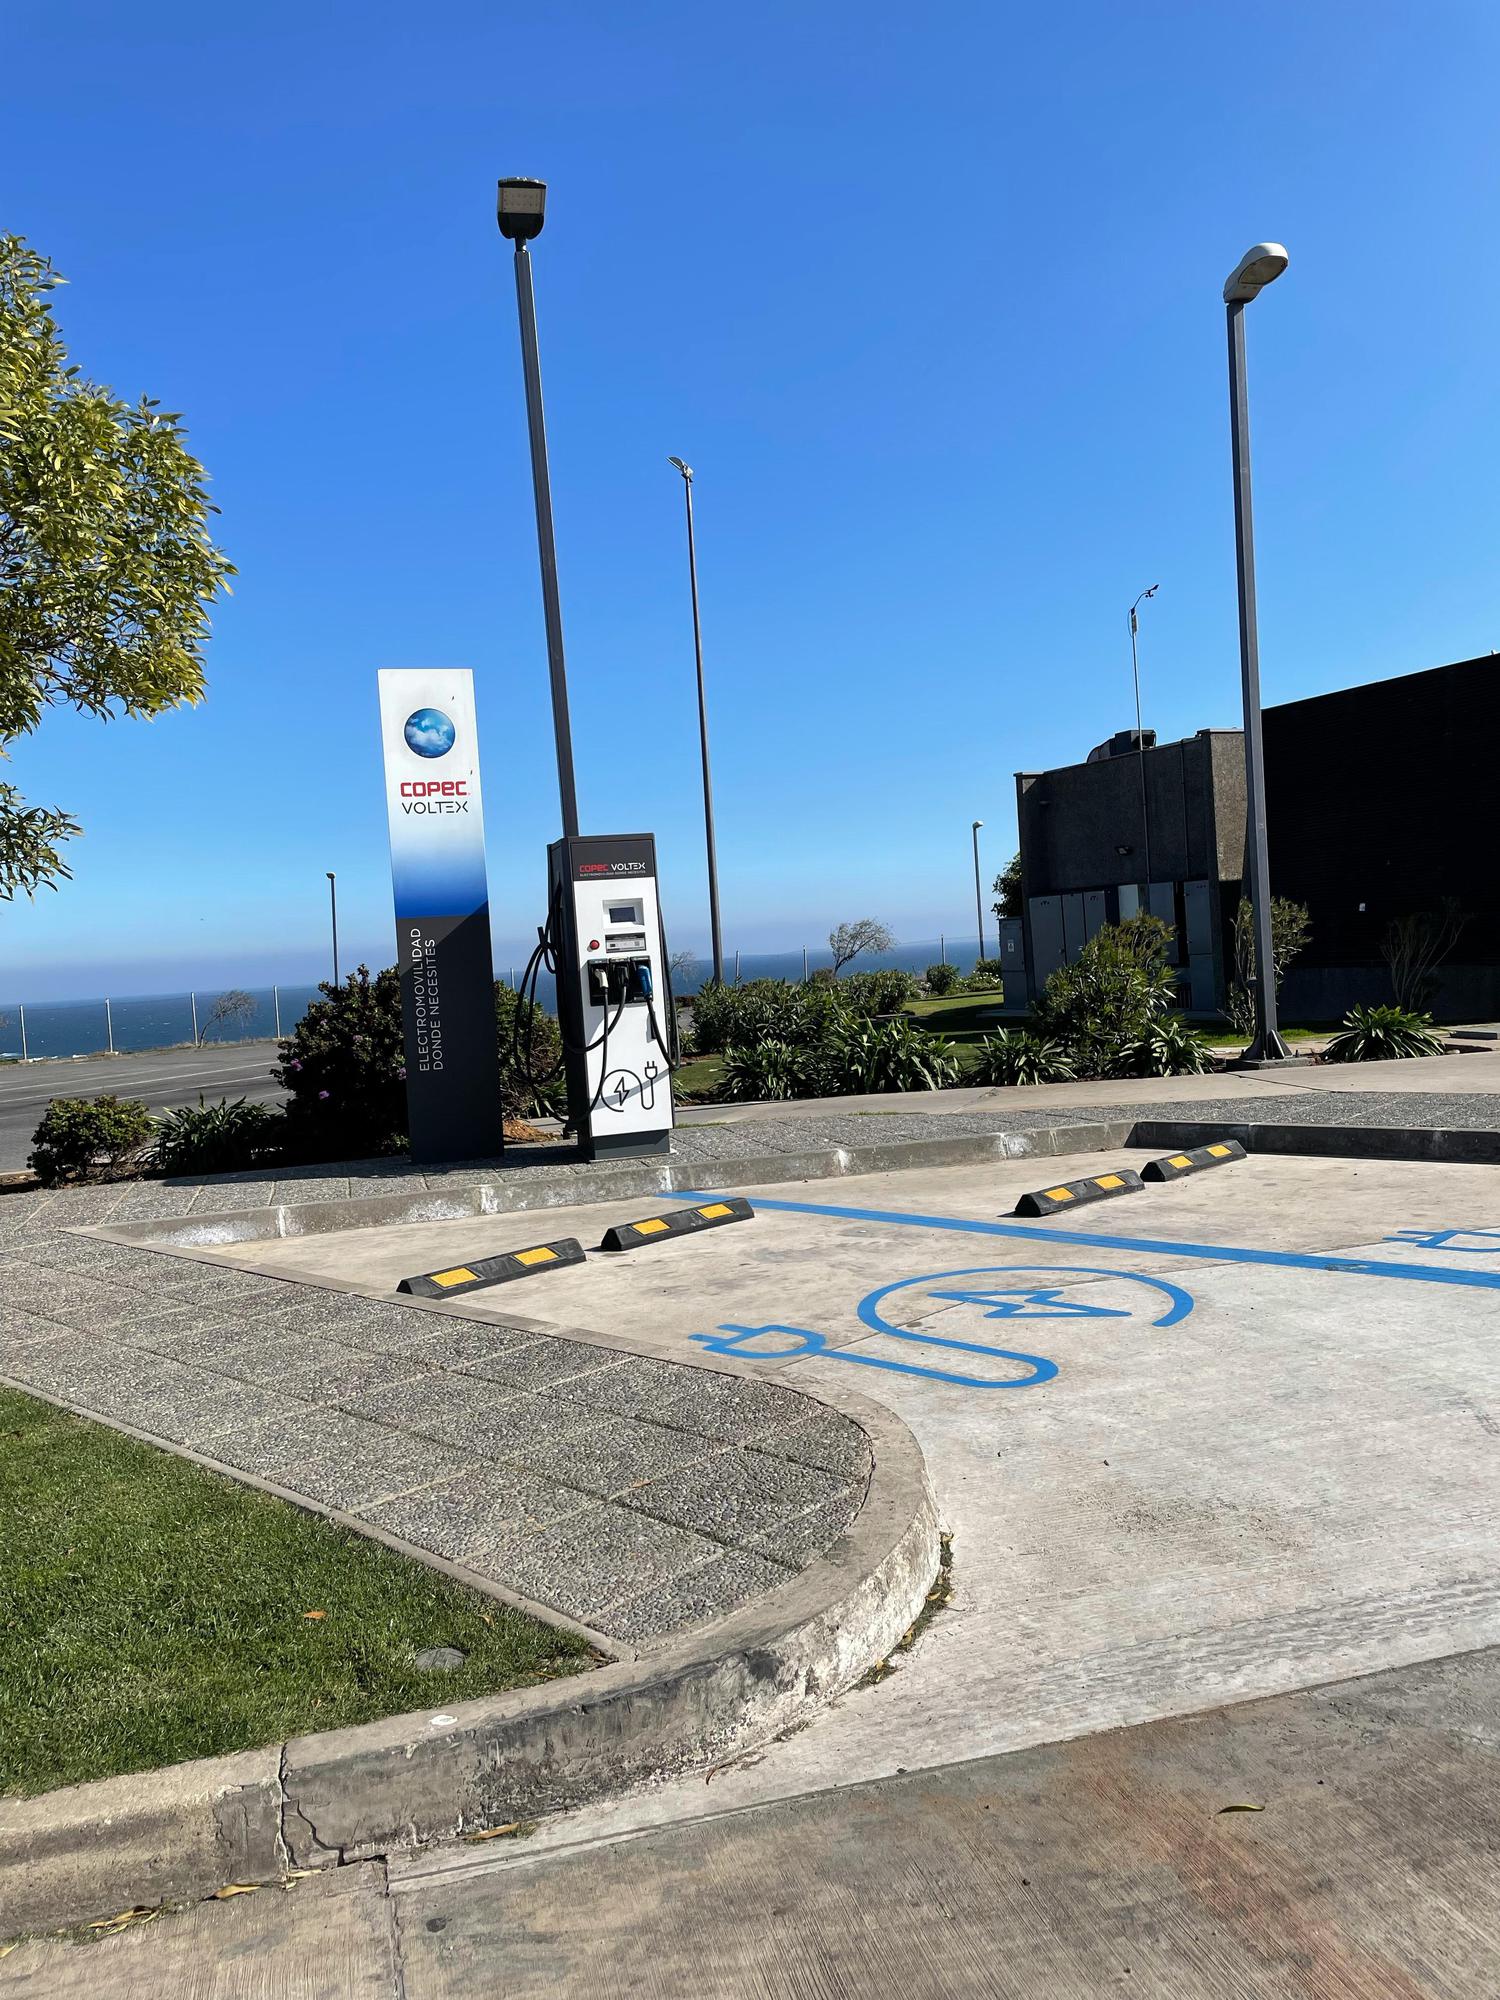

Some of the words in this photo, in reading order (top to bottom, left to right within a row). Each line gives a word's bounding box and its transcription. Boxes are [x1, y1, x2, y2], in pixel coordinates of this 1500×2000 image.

[401, 801, 469, 814] VOLTEX
[610, 862, 646, 871] VOLTEX
[410, 928, 429, 1071] ELECTROMOVILIDAD
[424, 939, 440, 1015] NECESITES
[430, 1020, 443, 1070] DONDE
